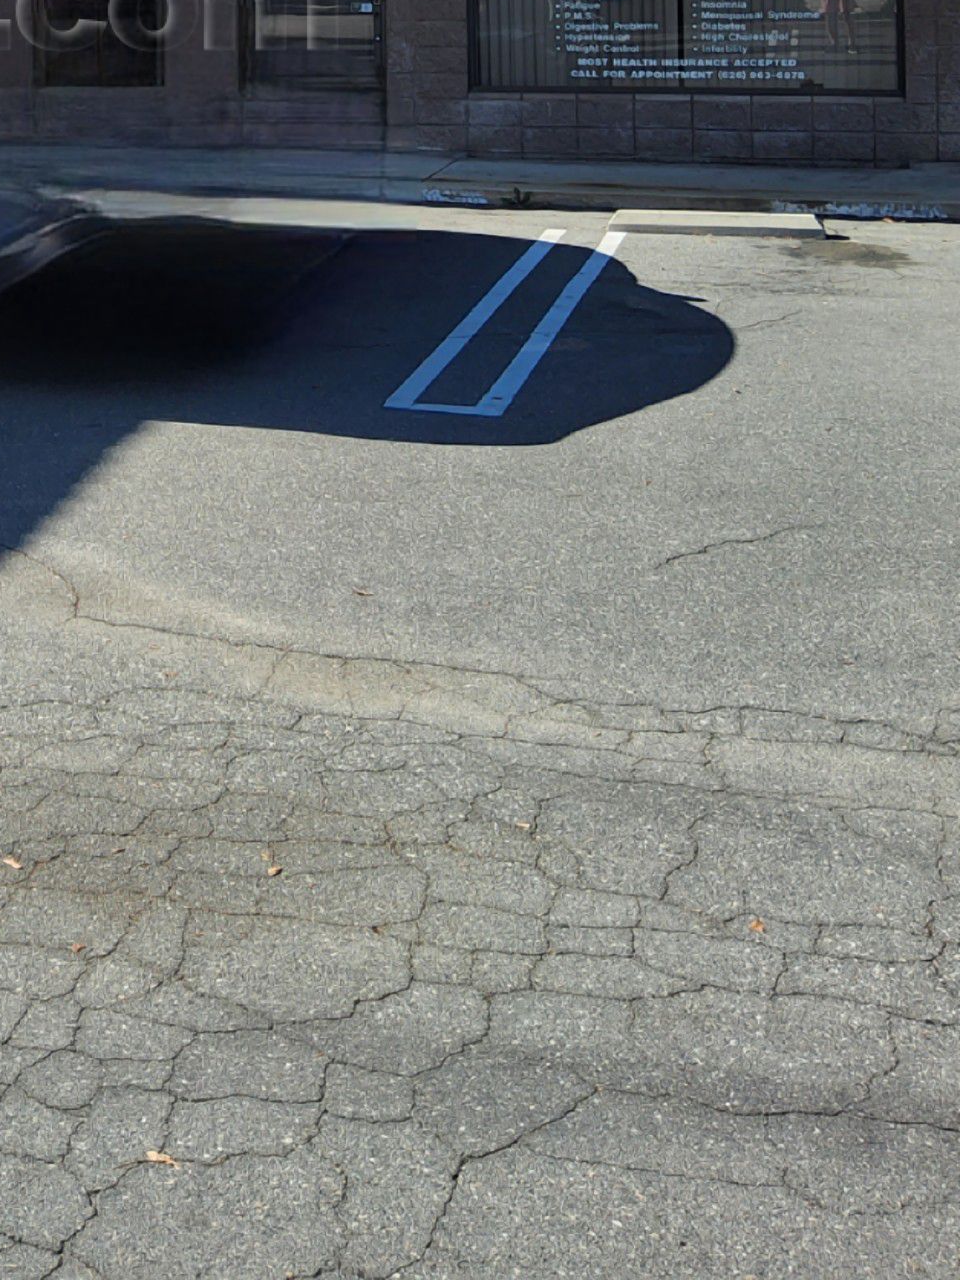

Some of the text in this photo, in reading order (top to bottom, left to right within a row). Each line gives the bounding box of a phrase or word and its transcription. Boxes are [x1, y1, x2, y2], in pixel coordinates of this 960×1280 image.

[577, 57, 797, 67] MOST HEALTH INSURANCE ACCEPTED
[570, 69, 600, 78] CALL
[603, 69, 626, 79] FOR
[631, 69, 714, 79] APPOINTMENT
